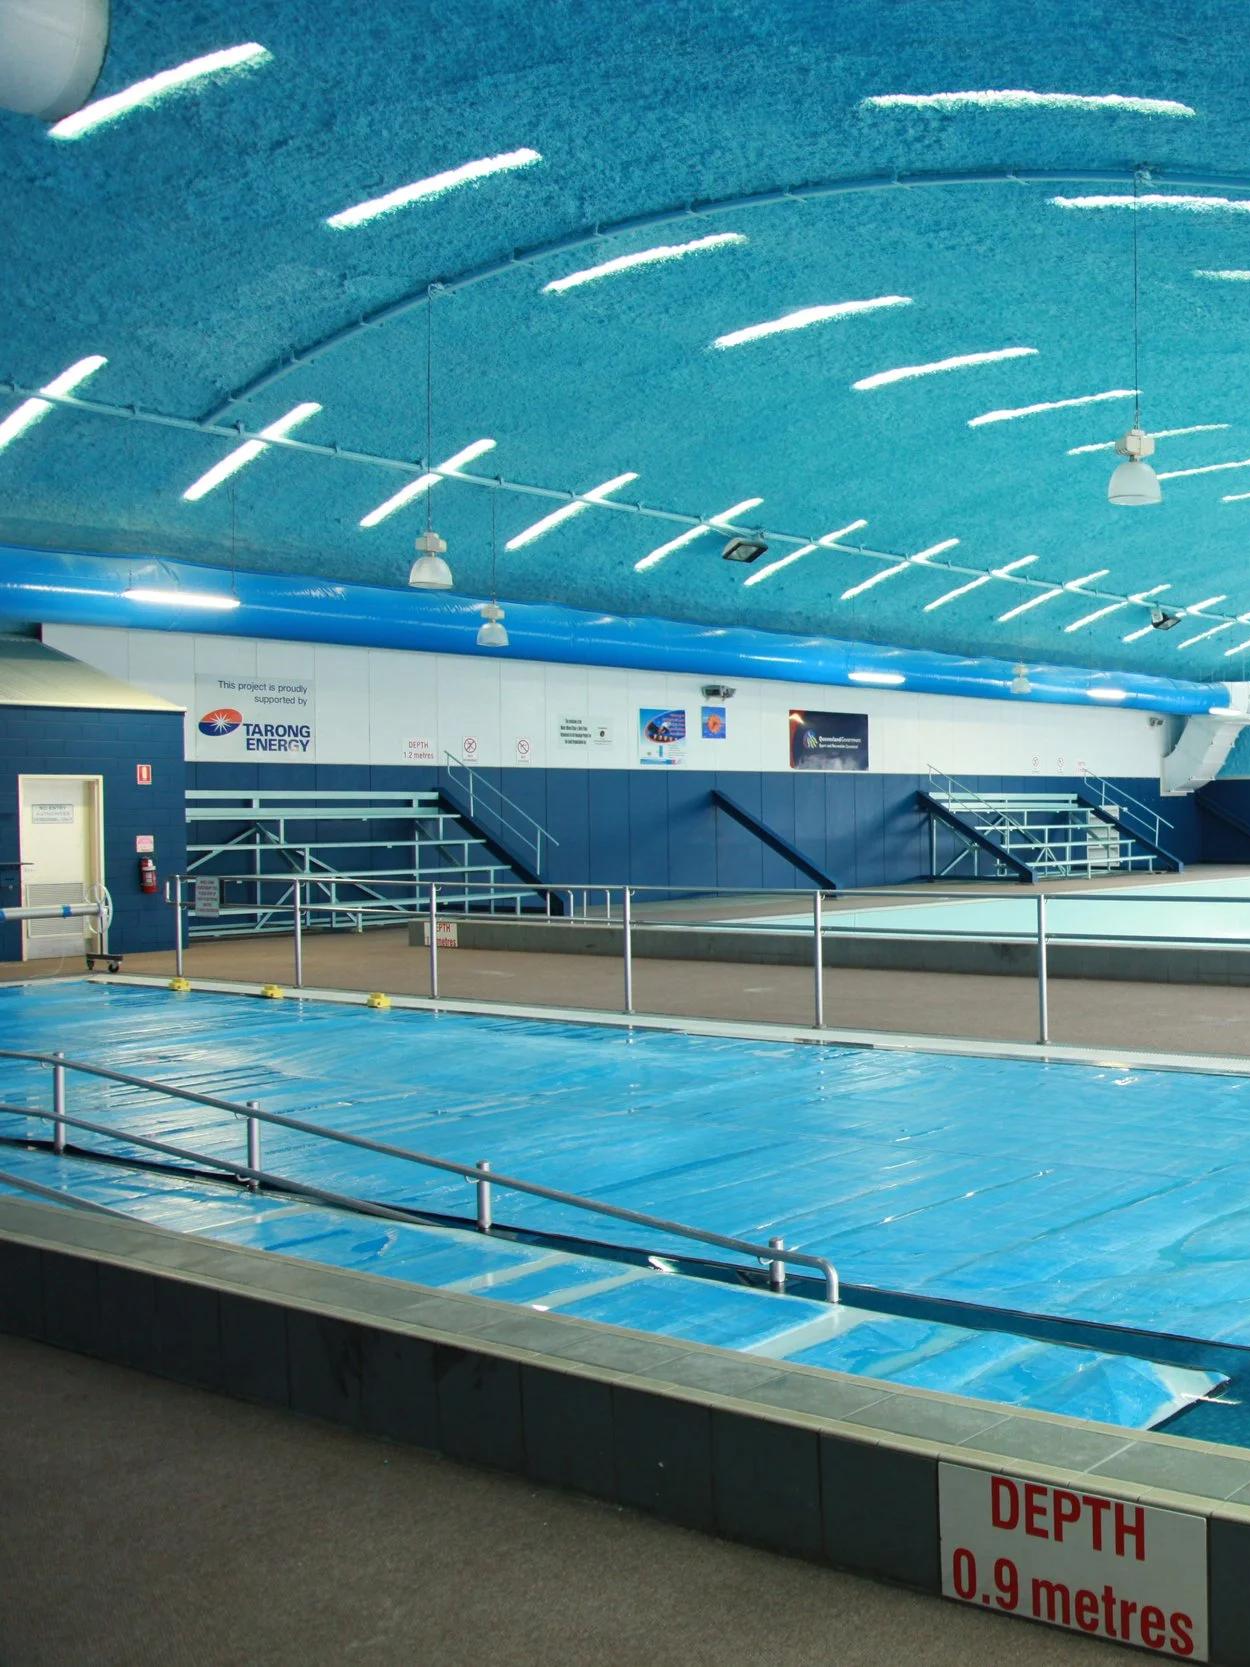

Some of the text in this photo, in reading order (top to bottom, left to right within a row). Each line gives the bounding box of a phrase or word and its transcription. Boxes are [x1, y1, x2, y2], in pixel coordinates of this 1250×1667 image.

[218, 680, 235, 689] This
[238, 682, 267, 692] project
[278, 685, 308, 695] proudly
[254, 696, 308, 706] supported by
[243, 723, 311, 738] TARONG
[246, 738, 310, 752] ENERGY
[408, 741, 429, 749] DEPTH
[991, 1475, 1146, 1562] DEPTH
[952, 1547, 1195, 1656] 0.9 metres
